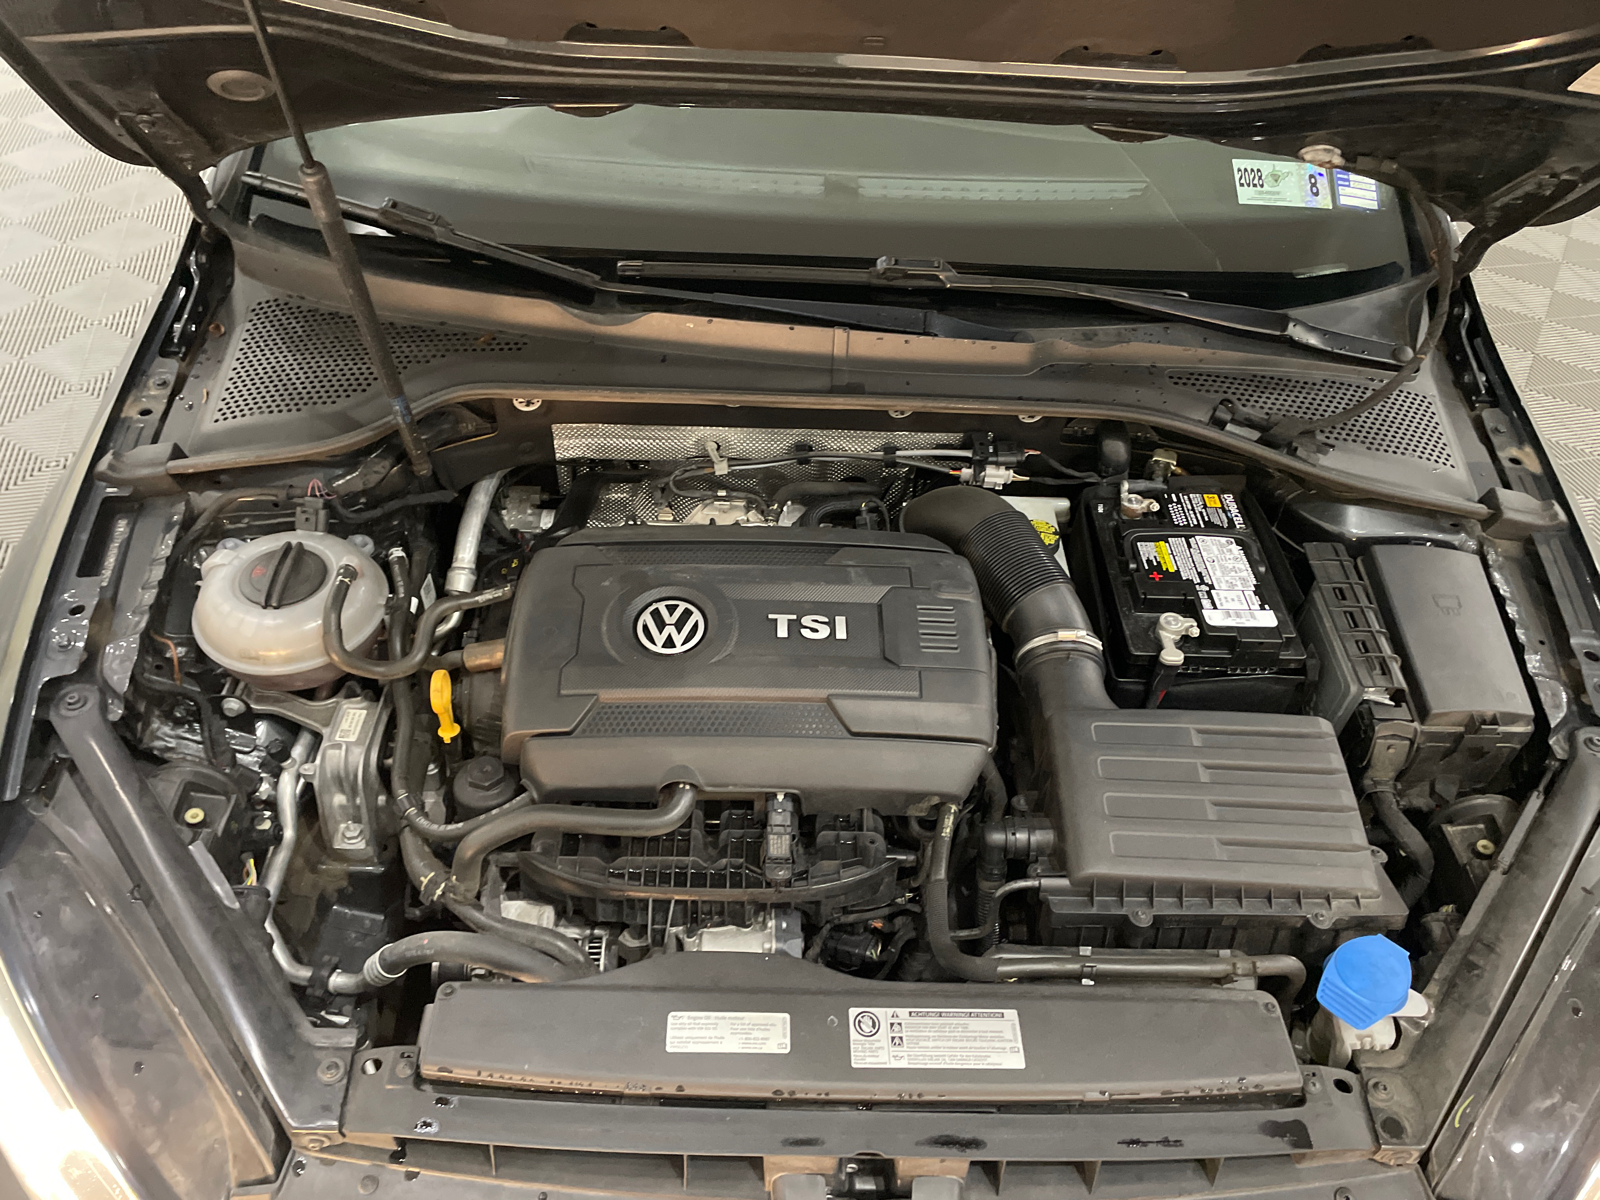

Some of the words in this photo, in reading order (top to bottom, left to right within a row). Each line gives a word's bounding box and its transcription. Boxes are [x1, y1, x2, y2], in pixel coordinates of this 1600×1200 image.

[1237, 167, 1264, 188] 2028
[1308, 173, 1319, 197] 8
[1224, 493, 1246, 529] DURACELL
[637, 599, 705, 655] VW
[768, 613, 848, 640] TSI
